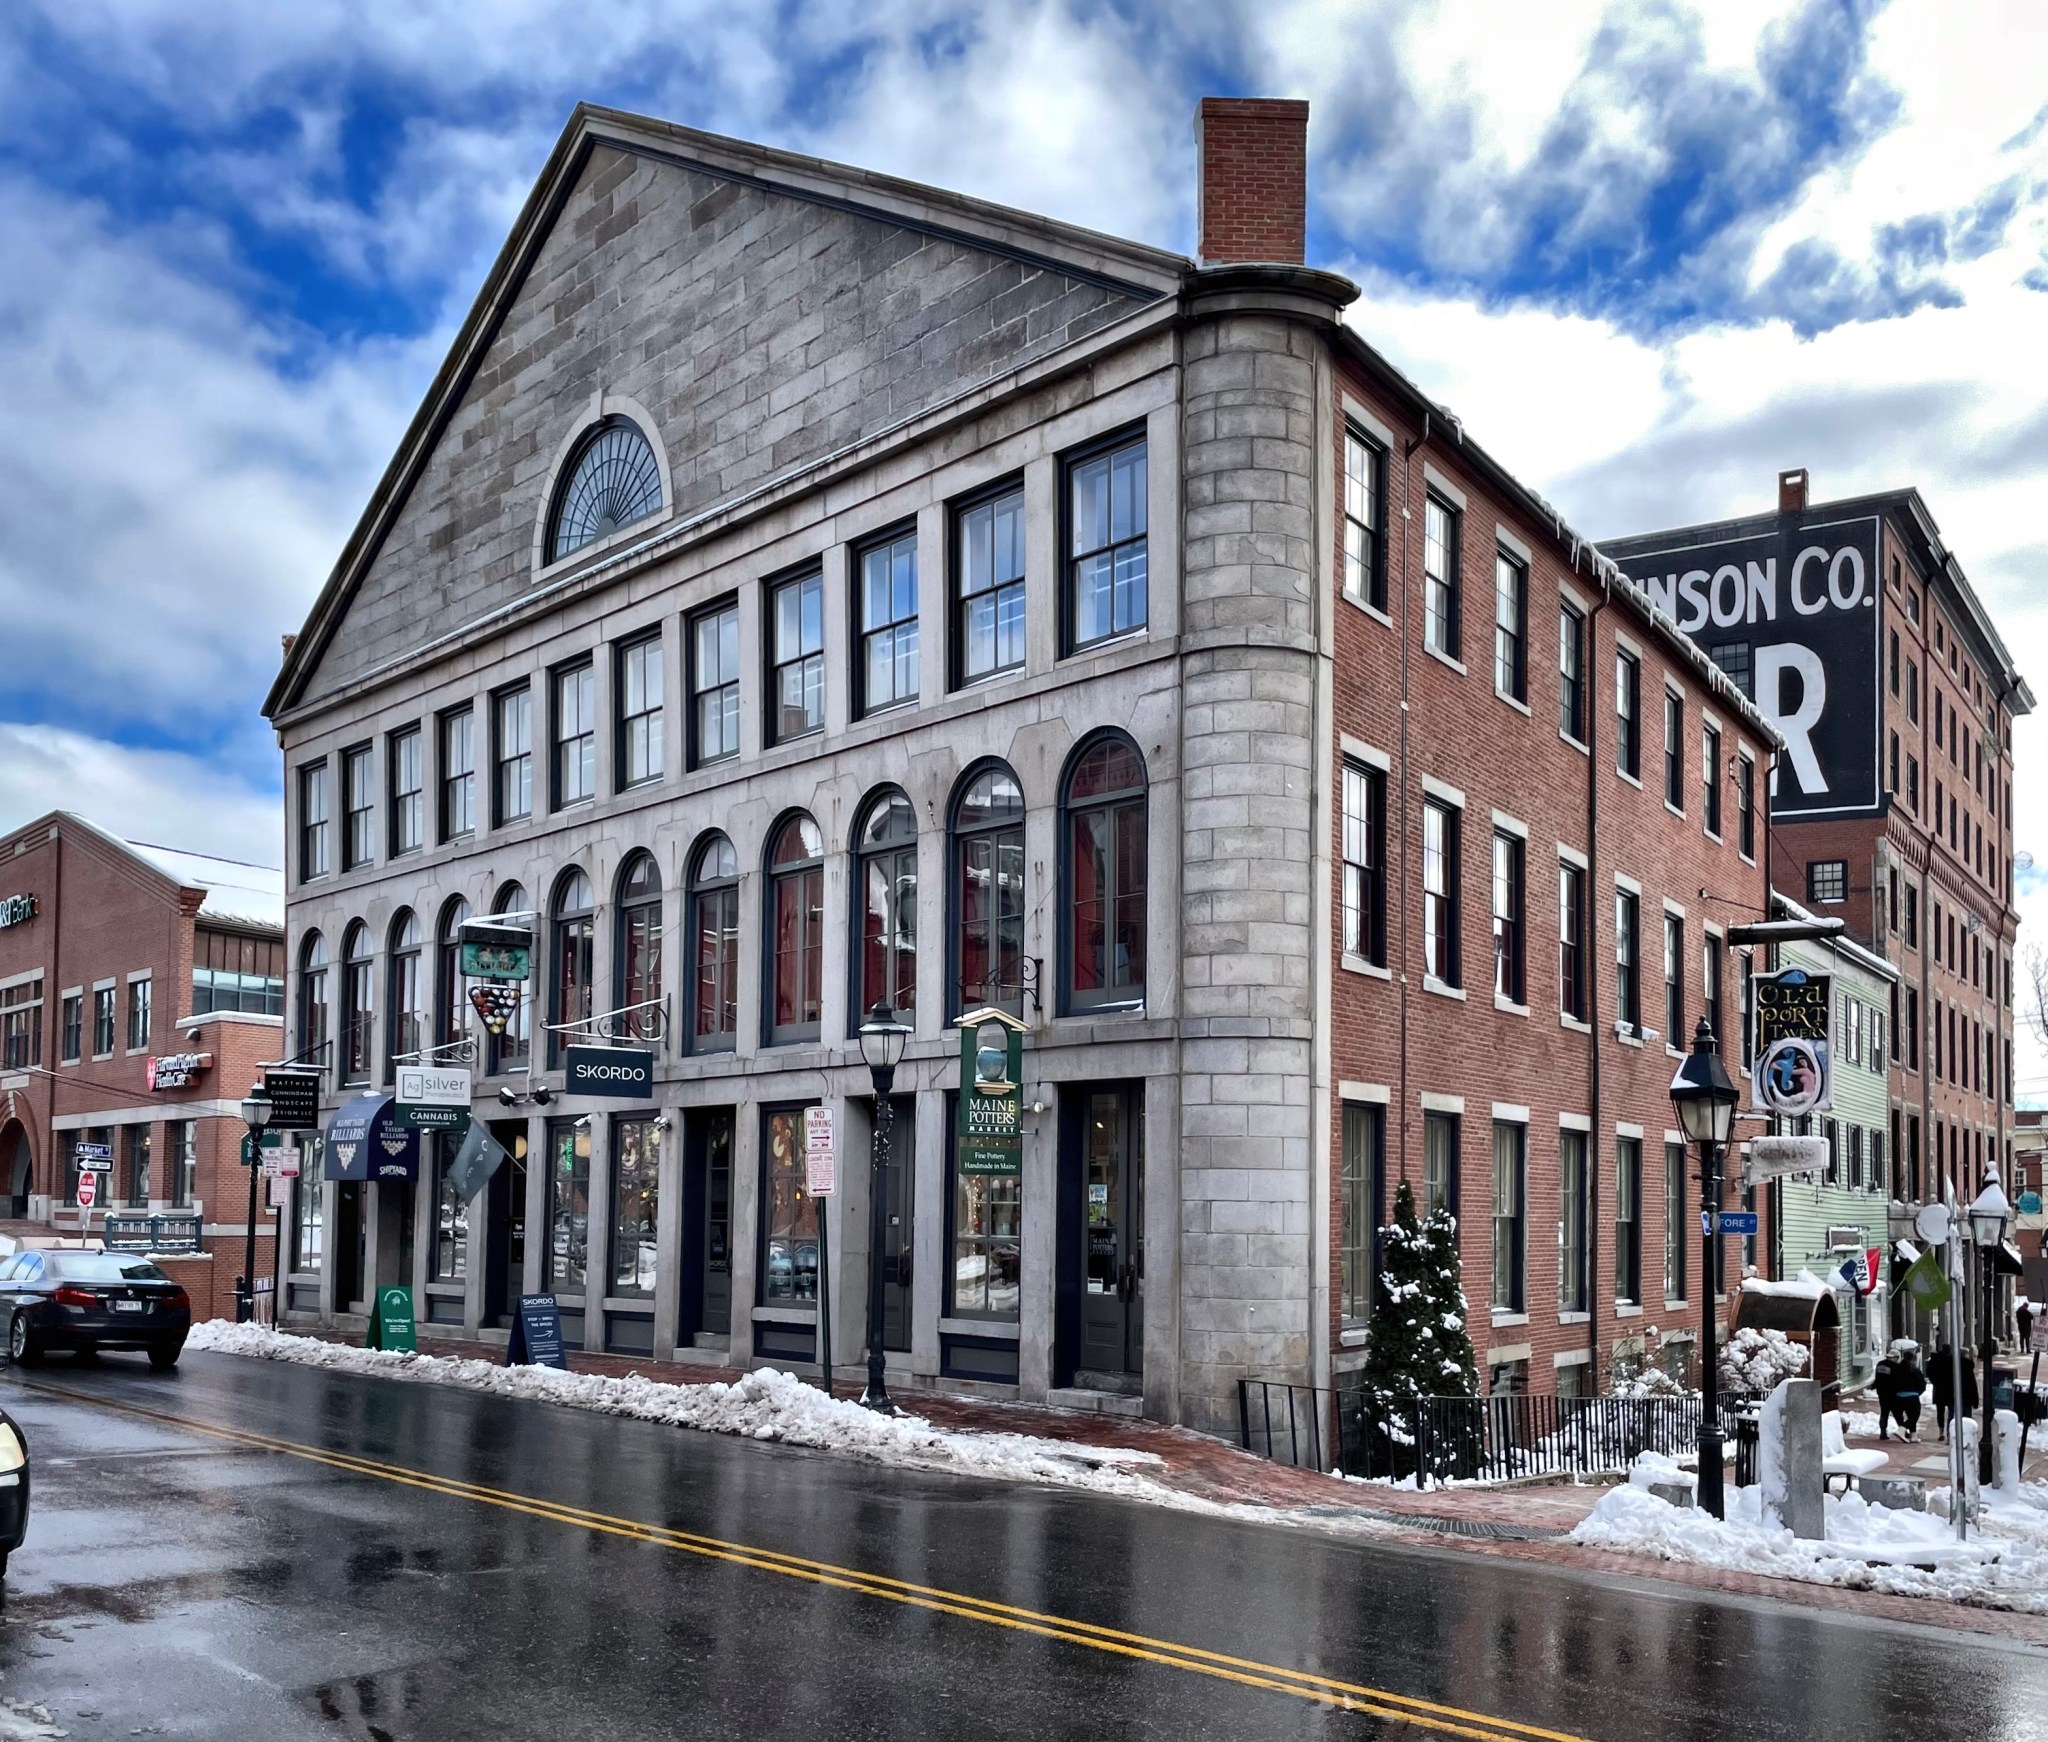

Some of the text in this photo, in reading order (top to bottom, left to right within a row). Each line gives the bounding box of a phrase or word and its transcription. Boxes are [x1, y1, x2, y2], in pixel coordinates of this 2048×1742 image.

[1791, 546, 1874, 616] CO.
[1755, 642, 1830, 797] R
[1769, 1024, 1828, 1038] TAVERN
[576, 1064, 645, 1081] SKORDO
[406, 1076, 465, 1092] Ag silver
[969, 1098, 1015, 1112] MAINE
[410, 1112, 458, 1121] CANNABIS
[814, 1110, 825, 1119] NO
[969, 1110, 1015, 1124] POTTERS
[807, 1120, 831, 1128] PARKING
[969, 1125, 1014, 1133] MARKET
[331, 1127, 365, 1141] BILLIARDS
[84, 1145, 103, 1154] Market
[974, 1151, 1005, 1161] Fine Pottery
[379, 1165, 407, 1176] SHIPYARD
[964, 1161, 993, 1169] Handmade
[1720, 1218, 1746, 1228] FORE
[1855, 1254, 1868, 1282] PEN
[522, 1297, 554, 1306] SKORDO
[2033, 1325, 2048, 1336] PARKIN
